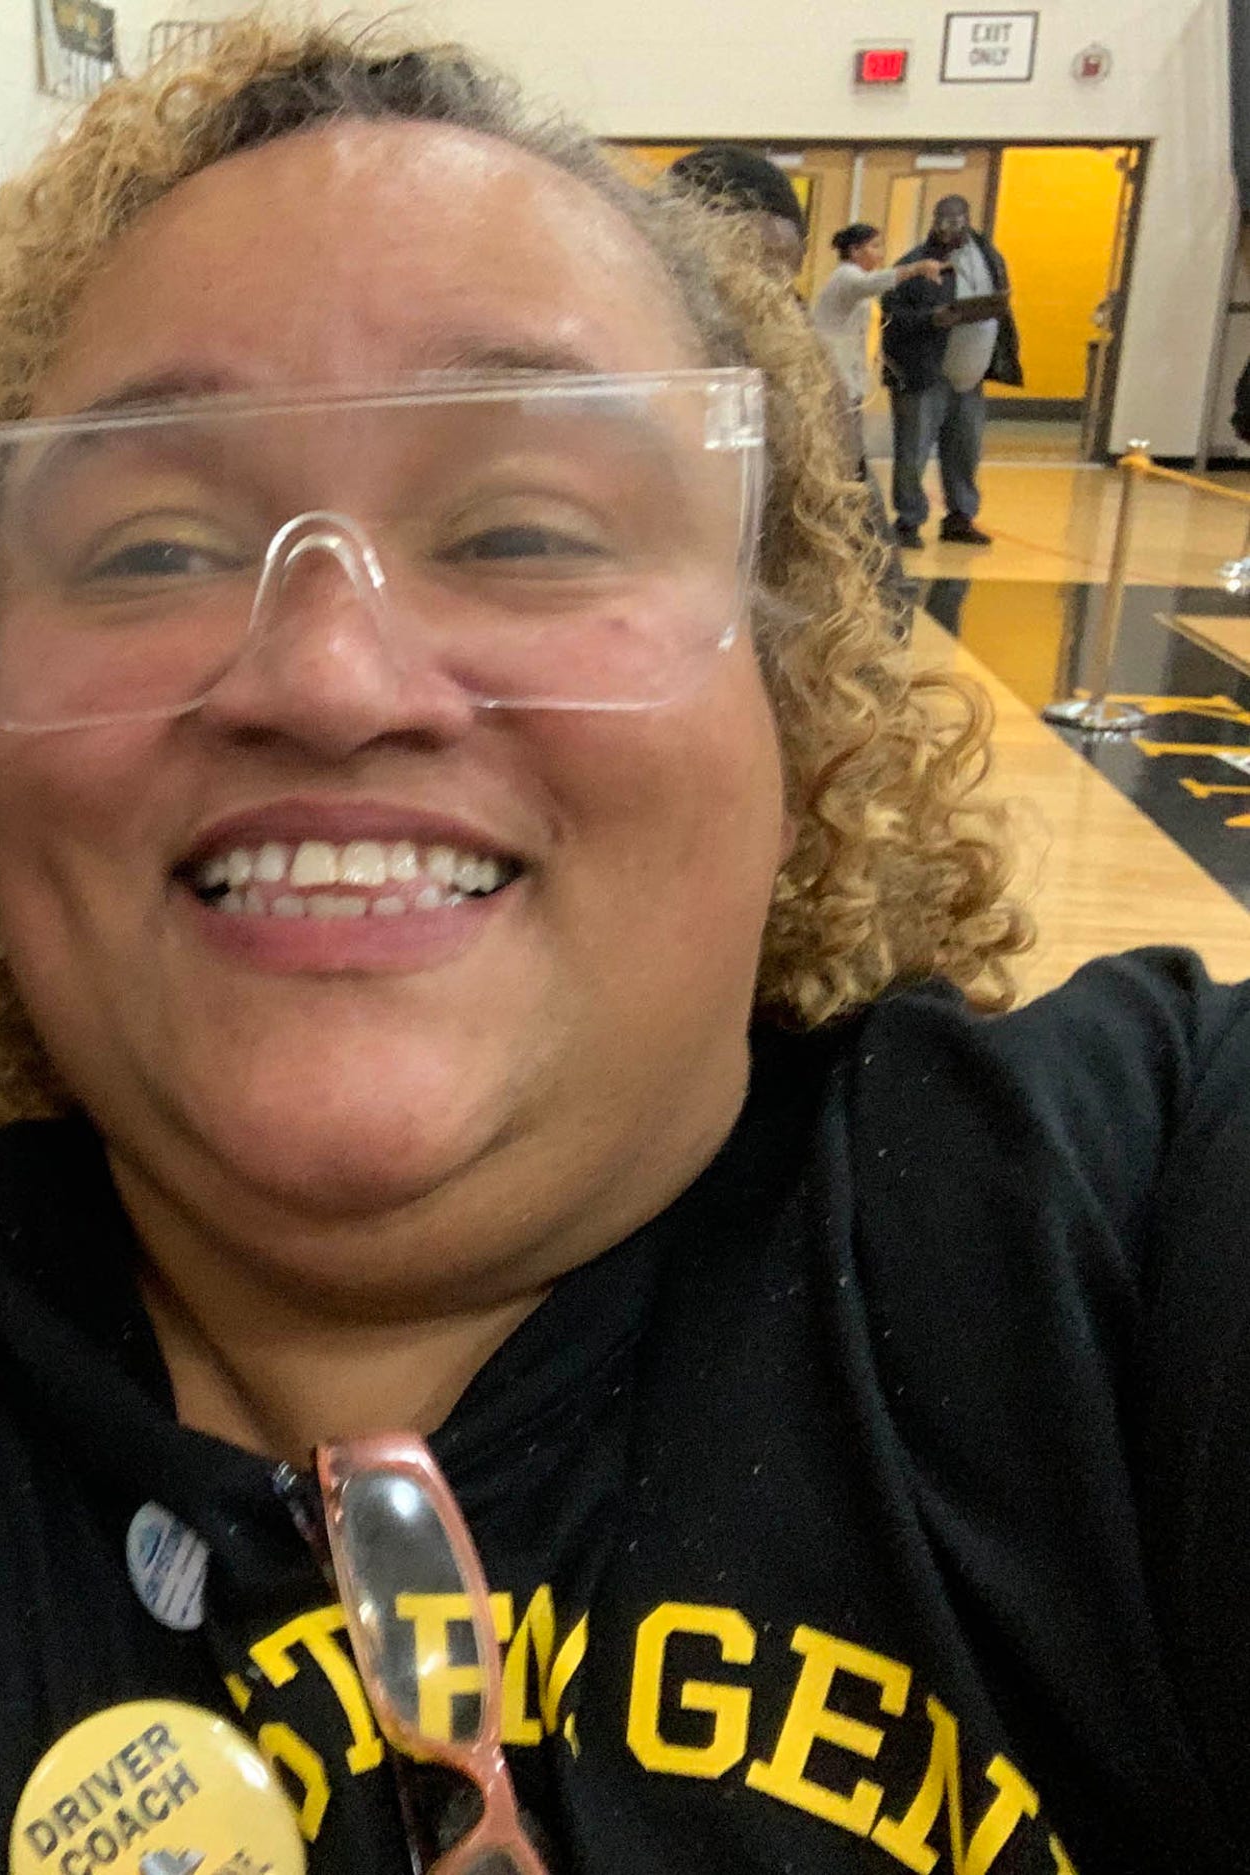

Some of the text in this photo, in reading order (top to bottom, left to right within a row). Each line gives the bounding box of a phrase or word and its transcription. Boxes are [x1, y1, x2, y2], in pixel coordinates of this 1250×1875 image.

[969, 46, 1009, 67] ONLY
[970, 22, 1013, 43] EXIT
[24, 1721, 180, 1860] DRIVER
[626, 1602, 1078, 1875] GEN
[59, 1759, 200, 1875] COACH
